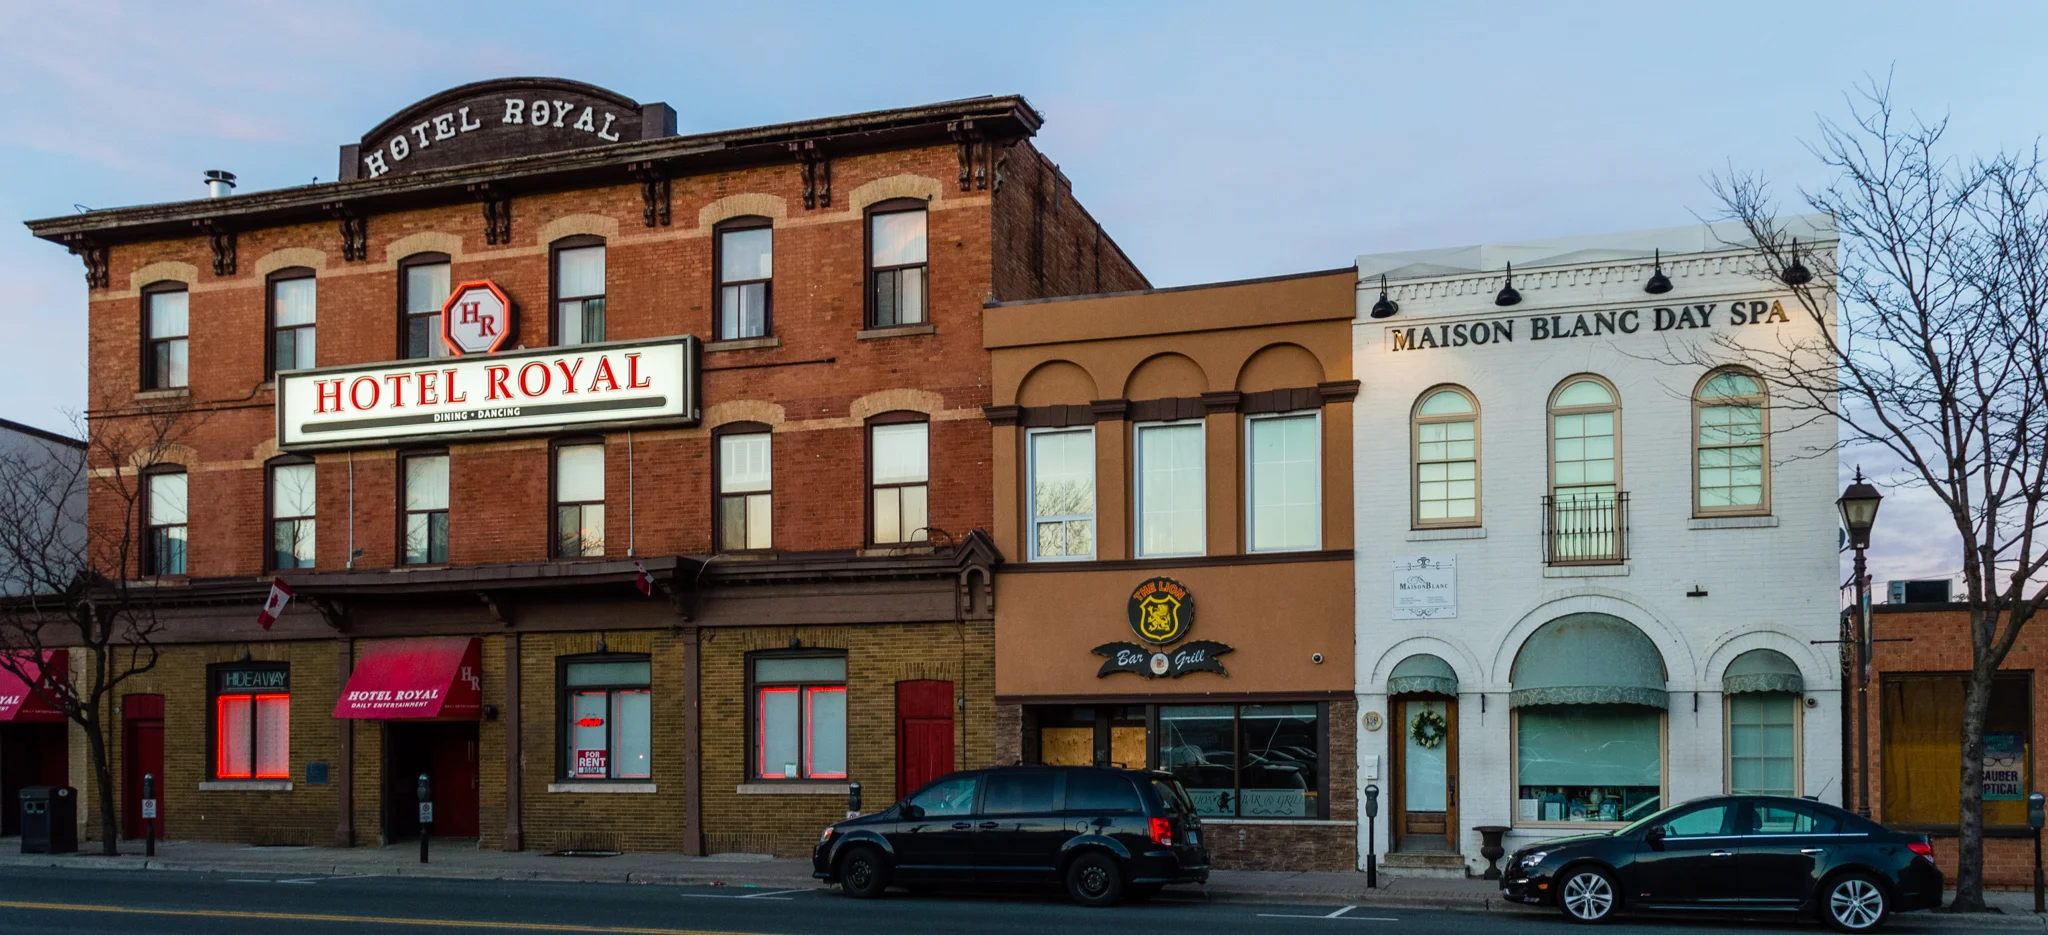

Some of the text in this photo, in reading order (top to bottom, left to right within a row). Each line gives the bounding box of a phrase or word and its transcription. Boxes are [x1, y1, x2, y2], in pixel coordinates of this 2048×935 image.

[364, 99, 620, 179] HOTEL ROYAL
[1392, 300, 1790, 352] MAISON BLANC DAY SPA
[313, 352, 651, 415] HOTEL ROYAL
[434, 406, 521, 423] DINING DANCING
[1133, 581, 1186, 601] THE LION
[1117, 649, 1205, 670] Bar Grill
[226, 671, 287, 687] HIDEAWAY
[348, 689, 439, 701] HOTEL ROYAL
[373, 701, 429, 709] ENTERTAINMENT
[579, 757, 606, 767] RENT
[1981, 783, 2019, 795] PTICAL
[1242, 794, 1262, 807] BAR
[1277, 794, 1304, 808] GRILL
